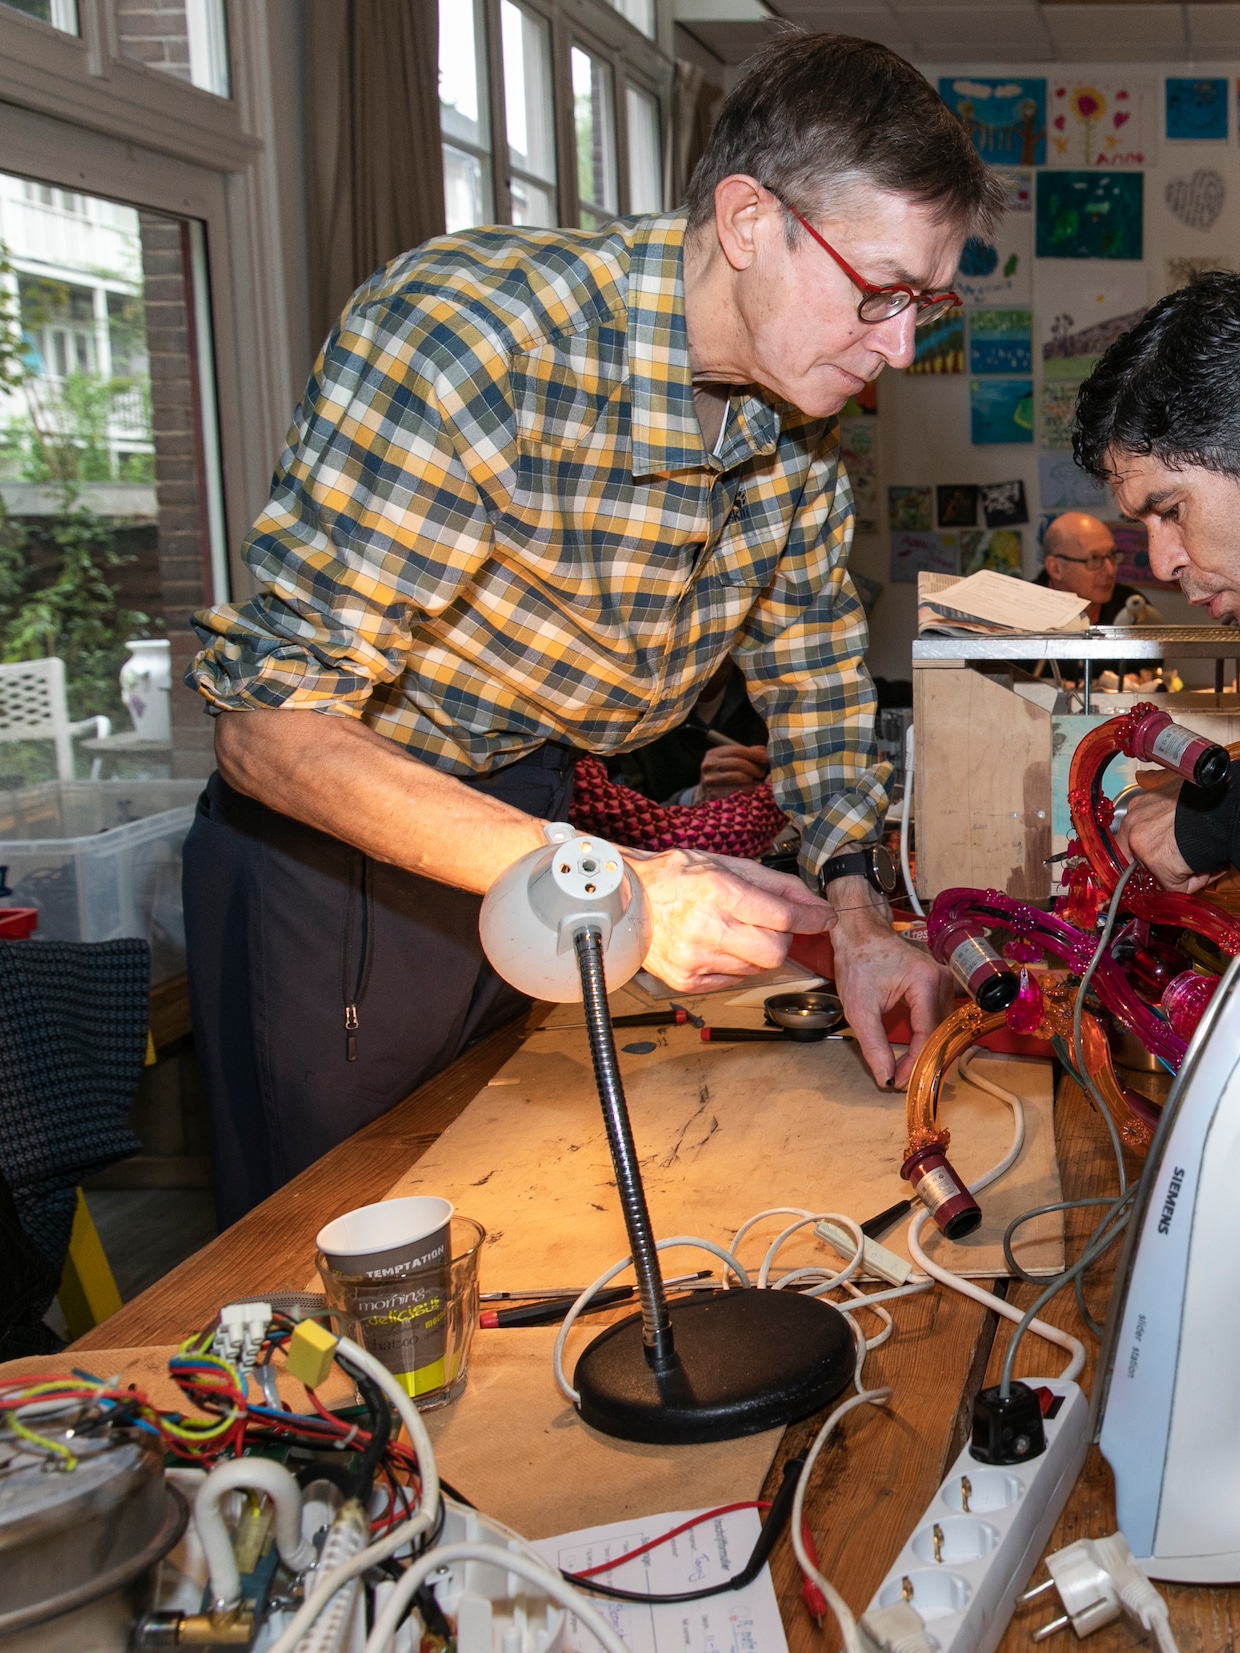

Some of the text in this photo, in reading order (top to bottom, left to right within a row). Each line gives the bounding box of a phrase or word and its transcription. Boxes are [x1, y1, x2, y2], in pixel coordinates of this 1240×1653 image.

[911, 929, 928, 940] tes
[1157, 1166, 1185, 1236] SIEMENS
[366, 1244, 444, 1279] TEMPTATION
[359, 1287, 426, 1312] morning
[1127, 1313, 1146, 1380] slider station
